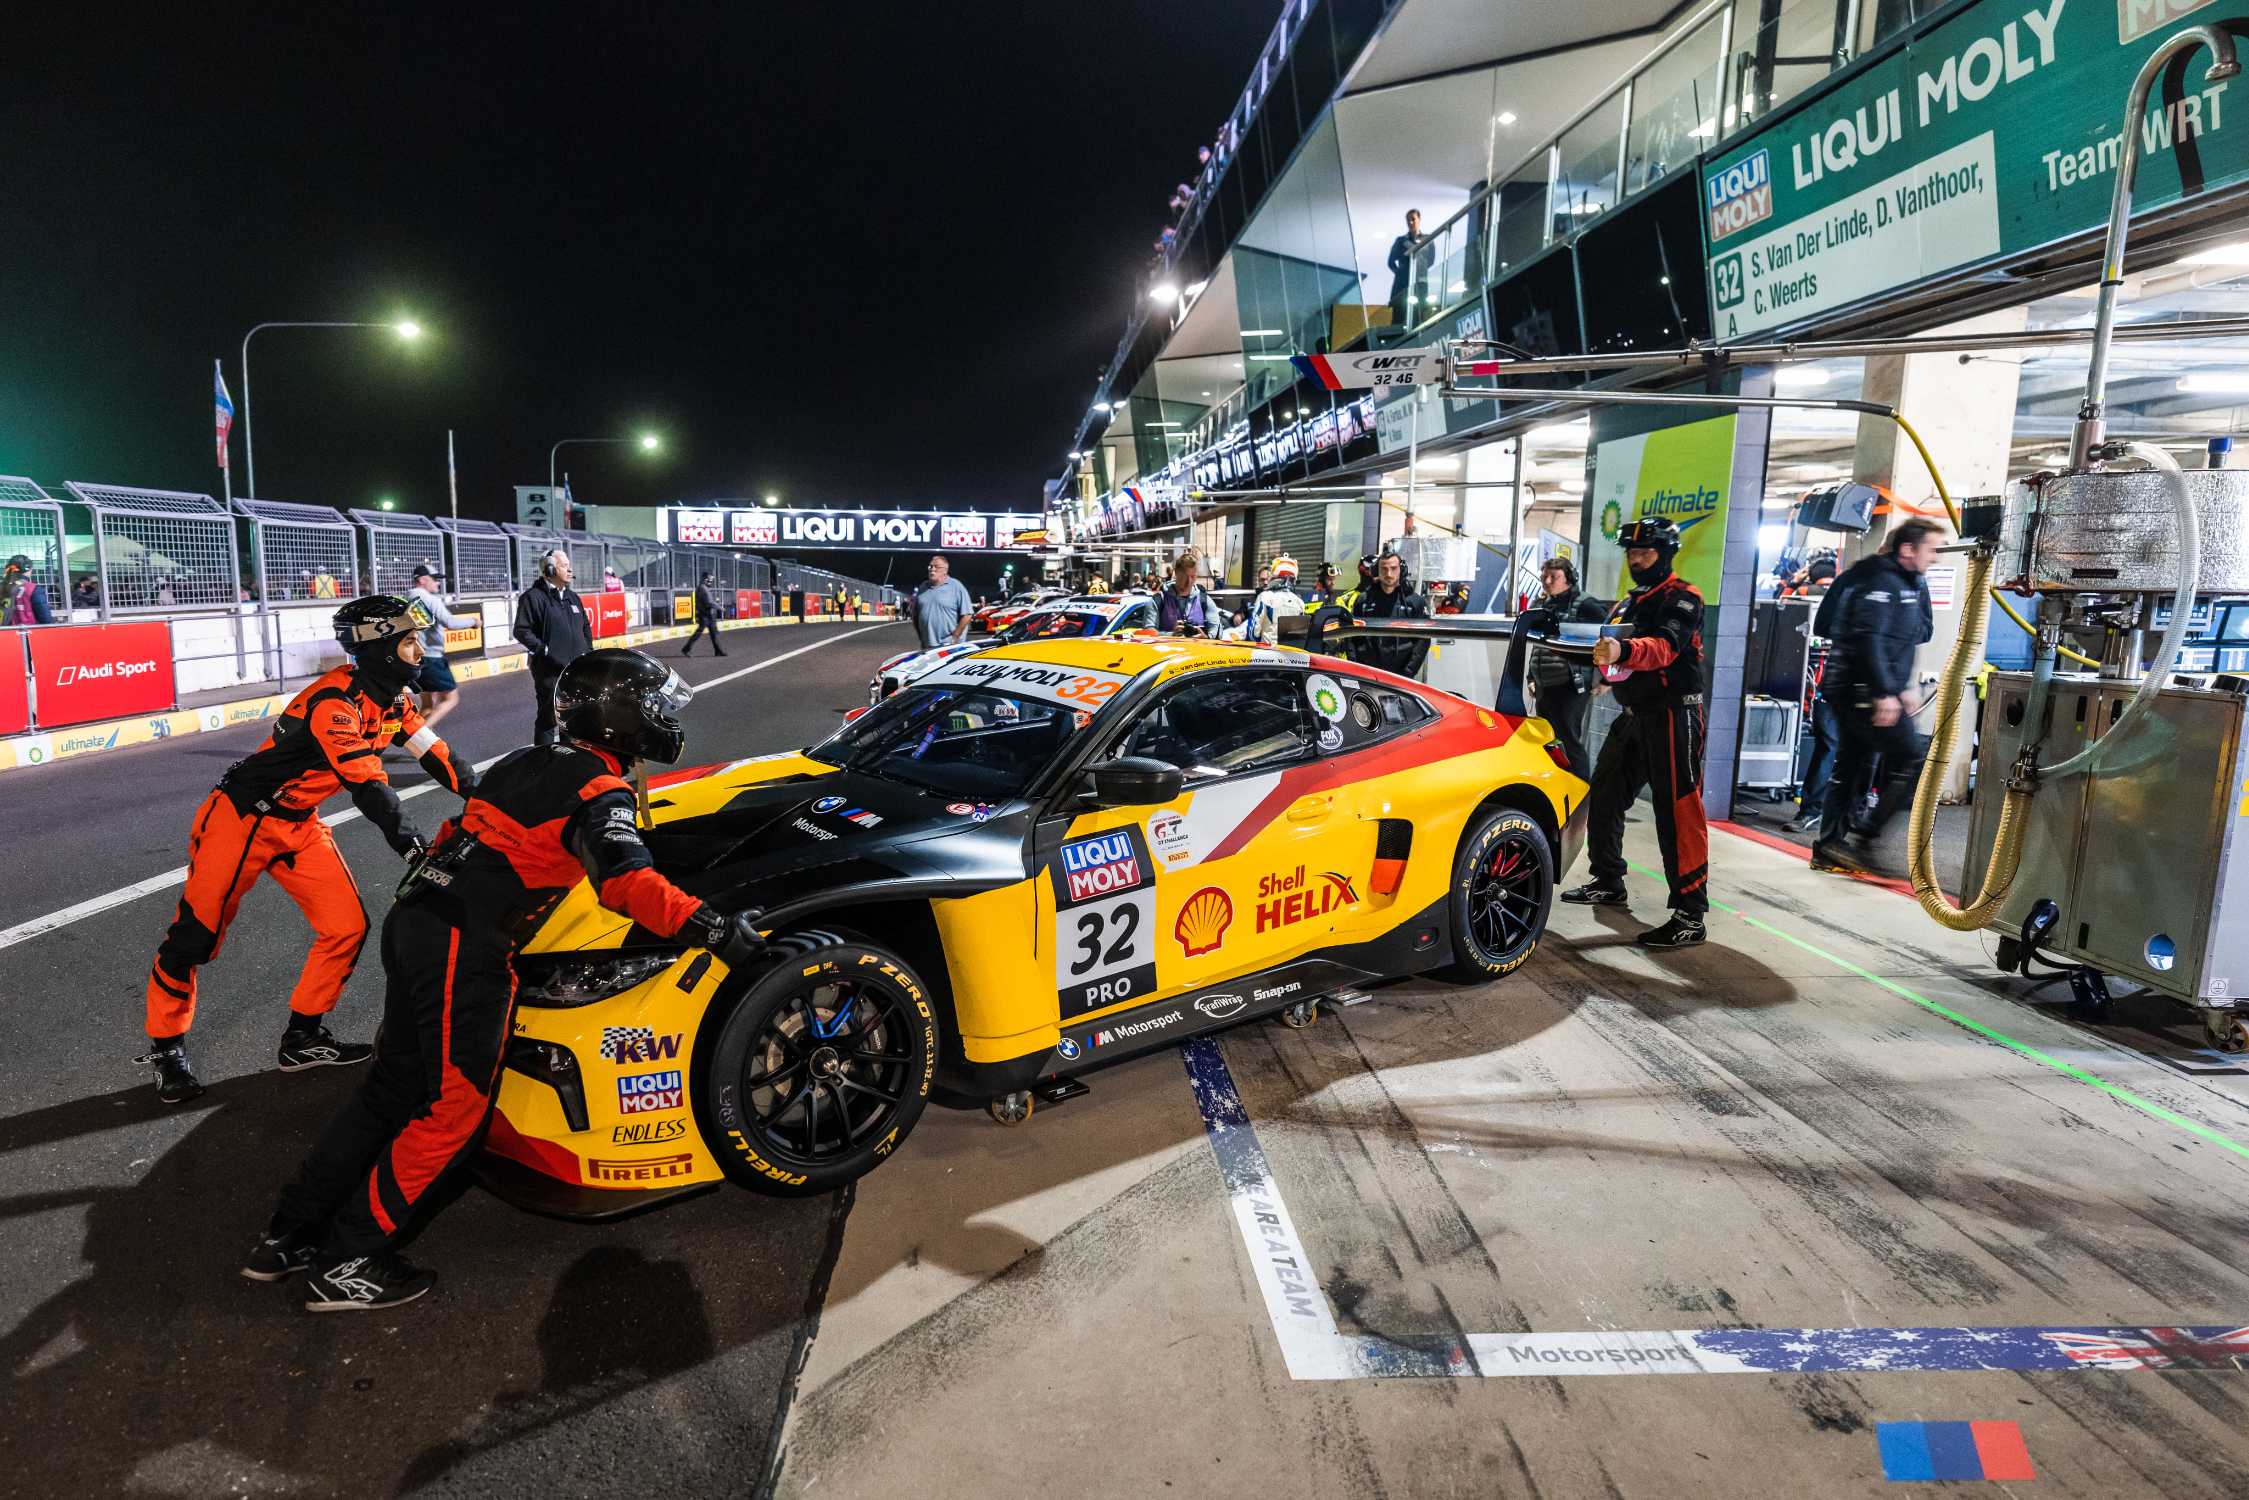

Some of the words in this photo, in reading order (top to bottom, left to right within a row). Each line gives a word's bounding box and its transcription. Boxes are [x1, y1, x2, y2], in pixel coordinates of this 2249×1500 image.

[1792, 88, 1902, 190] LIQUI
[1918, 0, 2066, 128] MOLY
[2042, 133, 2125, 192] Team
[2141, 81, 2229, 155] WRT
[1710, 155, 1767, 206] LIQUI
[1713, 185, 1769, 238] MOLY
[1751, 251, 1765, 279] S.
[1766, 243, 1793, 272] Van
[1796, 230, 1822, 260] Der
[1825, 209, 1873, 249] Linde,
[1876, 196, 1893, 229] D.
[1895, 161, 1984, 219] Vanthoor,
[1717, 259, 1742, 305] 32
[1754, 288, 1767, 316] C.
[1769, 271, 1818, 310] Weerts
[1728, 312, 1739, 337] A
[1371, 354, 1427, 370] WRT
[1374, 375, 1392, 386] 32
[1396, 373, 1414, 384] 46
[1641, 484, 1720, 517] ultimate
[681, 527, 722, 541] MOLY
[734, 528, 776, 542] MOLY
[783, 515, 854, 542] LIQUI
[863, 518, 938, 543] MOLY
[944, 532, 985, 546] MOLY
[445, 630, 478, 643] IRELLI
[77, 662, 114, 681] Audi
[115, 659, 157, 678] Sport
[1007, 666, 1078, 687] MOLY
[1055, 676, 1122, 706] 32
[60, 735, 105, 753] ultimate
[1320, 728, 1338, 741] FOX
[1065, 832, 1130, 871] LIQUI
[1072, 859, 1135, 898] MOLY
[1257, 864, 1306, 898] Shell
[1255, 875, 1357, 935] HELIX
[1070, 902, 1140, 976] 32
[1486, 938, 1537, 973] PIRELLI
[1085, 977, 1132, 1007] PRO
[1115, 1010, 1184, 1040] Motorsport
[1199, 994, 1244, 1013] GrafiWrap
[1252, 981, 1302, 1001] Snap-on
[615, 1033, 684, 1065] KW
[620, 1071, 679, 1095] LIQUI
[621, 1090, 681, 1114] MOLY
[611, 1117, 688, 1144] ENDLESS
[588, 1152, 694, 1181] PIRELLI
[727, 1129, 808, 1186] PIRELLI
[1249, 1198, 1285, 1238] ARE
[1271, 1256, 1317, 1318] TEAM
[1505, 1344, 1694, 1366] Motorsport
